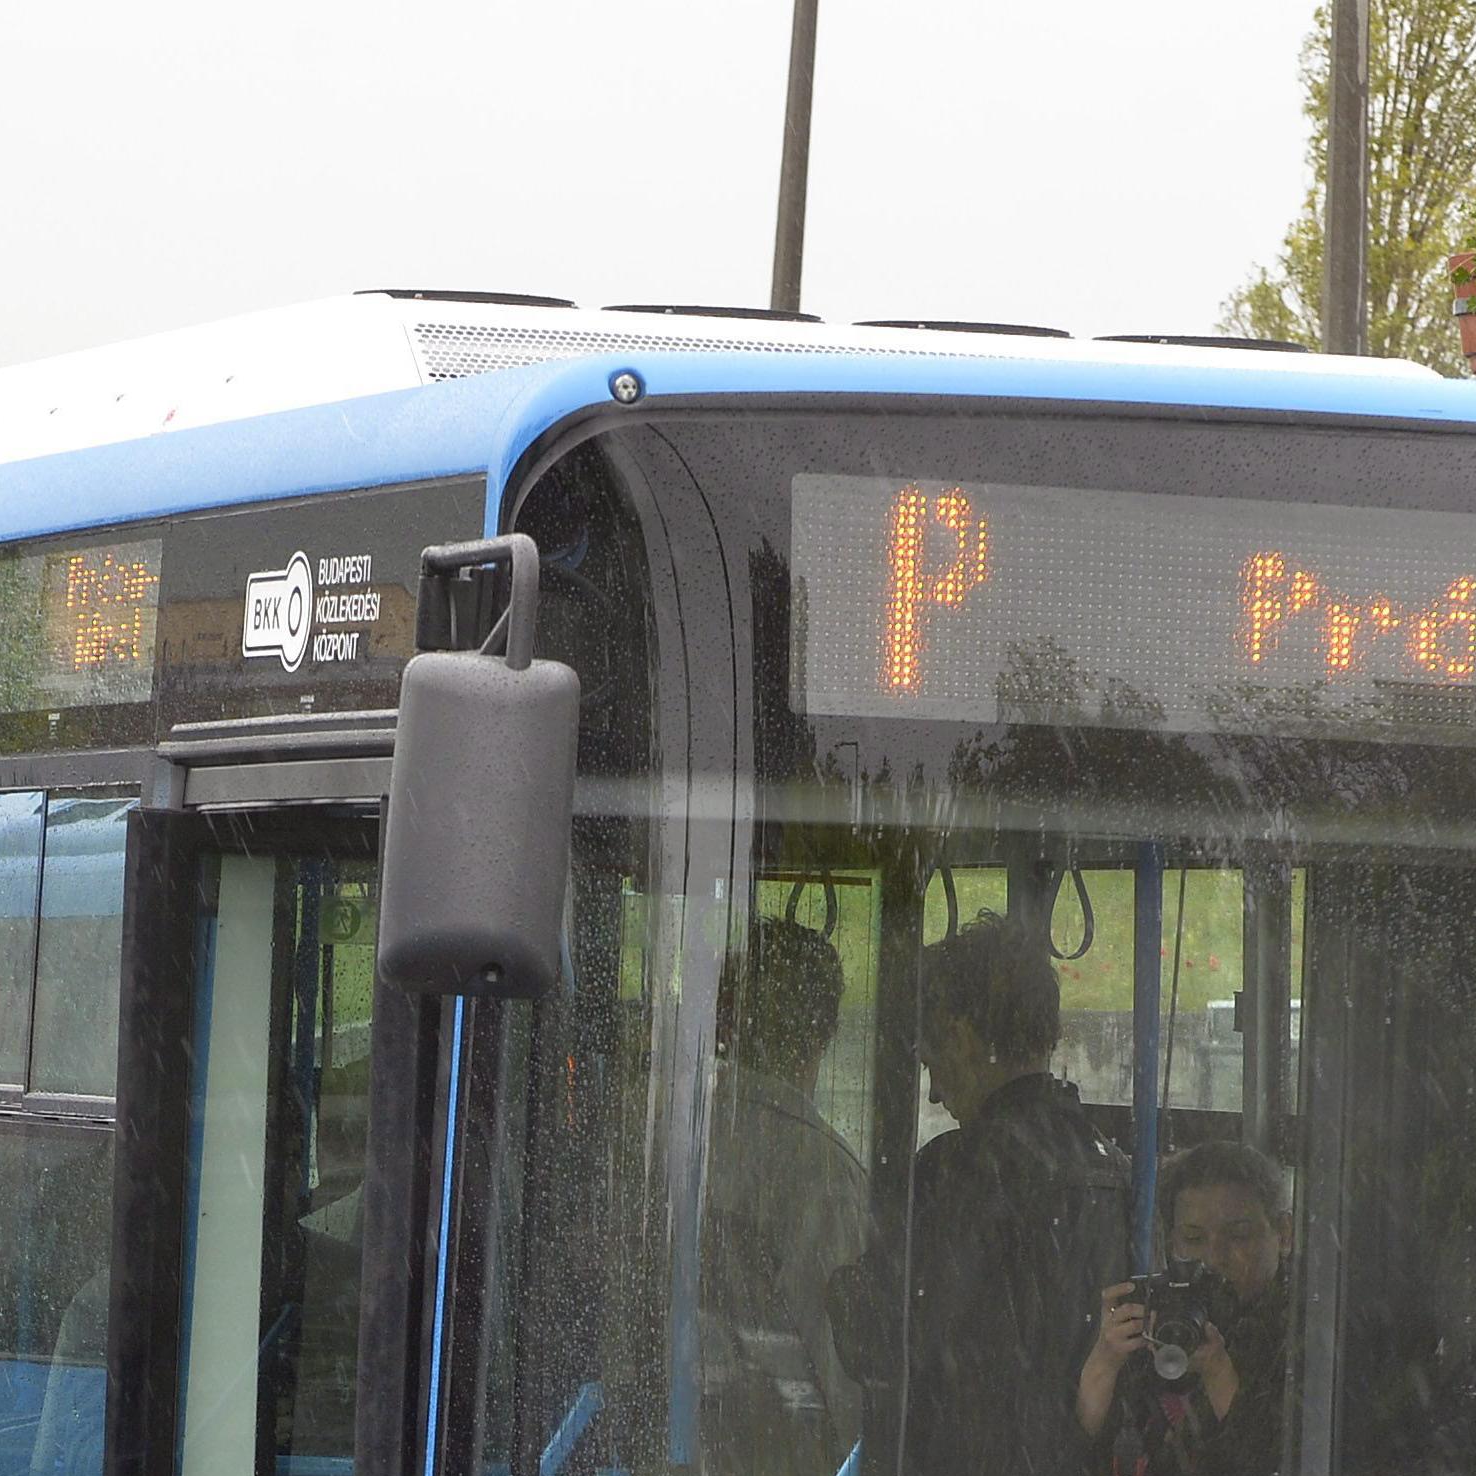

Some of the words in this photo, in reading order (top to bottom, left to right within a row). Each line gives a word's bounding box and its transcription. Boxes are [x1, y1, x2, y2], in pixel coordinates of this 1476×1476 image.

[318, 554, 372, 586] BUDAPESTI
[315, 586, 381, 624] KÖZLEKEDÉSI
[884, 483, 990, 694] P
[253, 596, 282, 631] BKK
[312, 628, 360, 662] KÖZPONT
